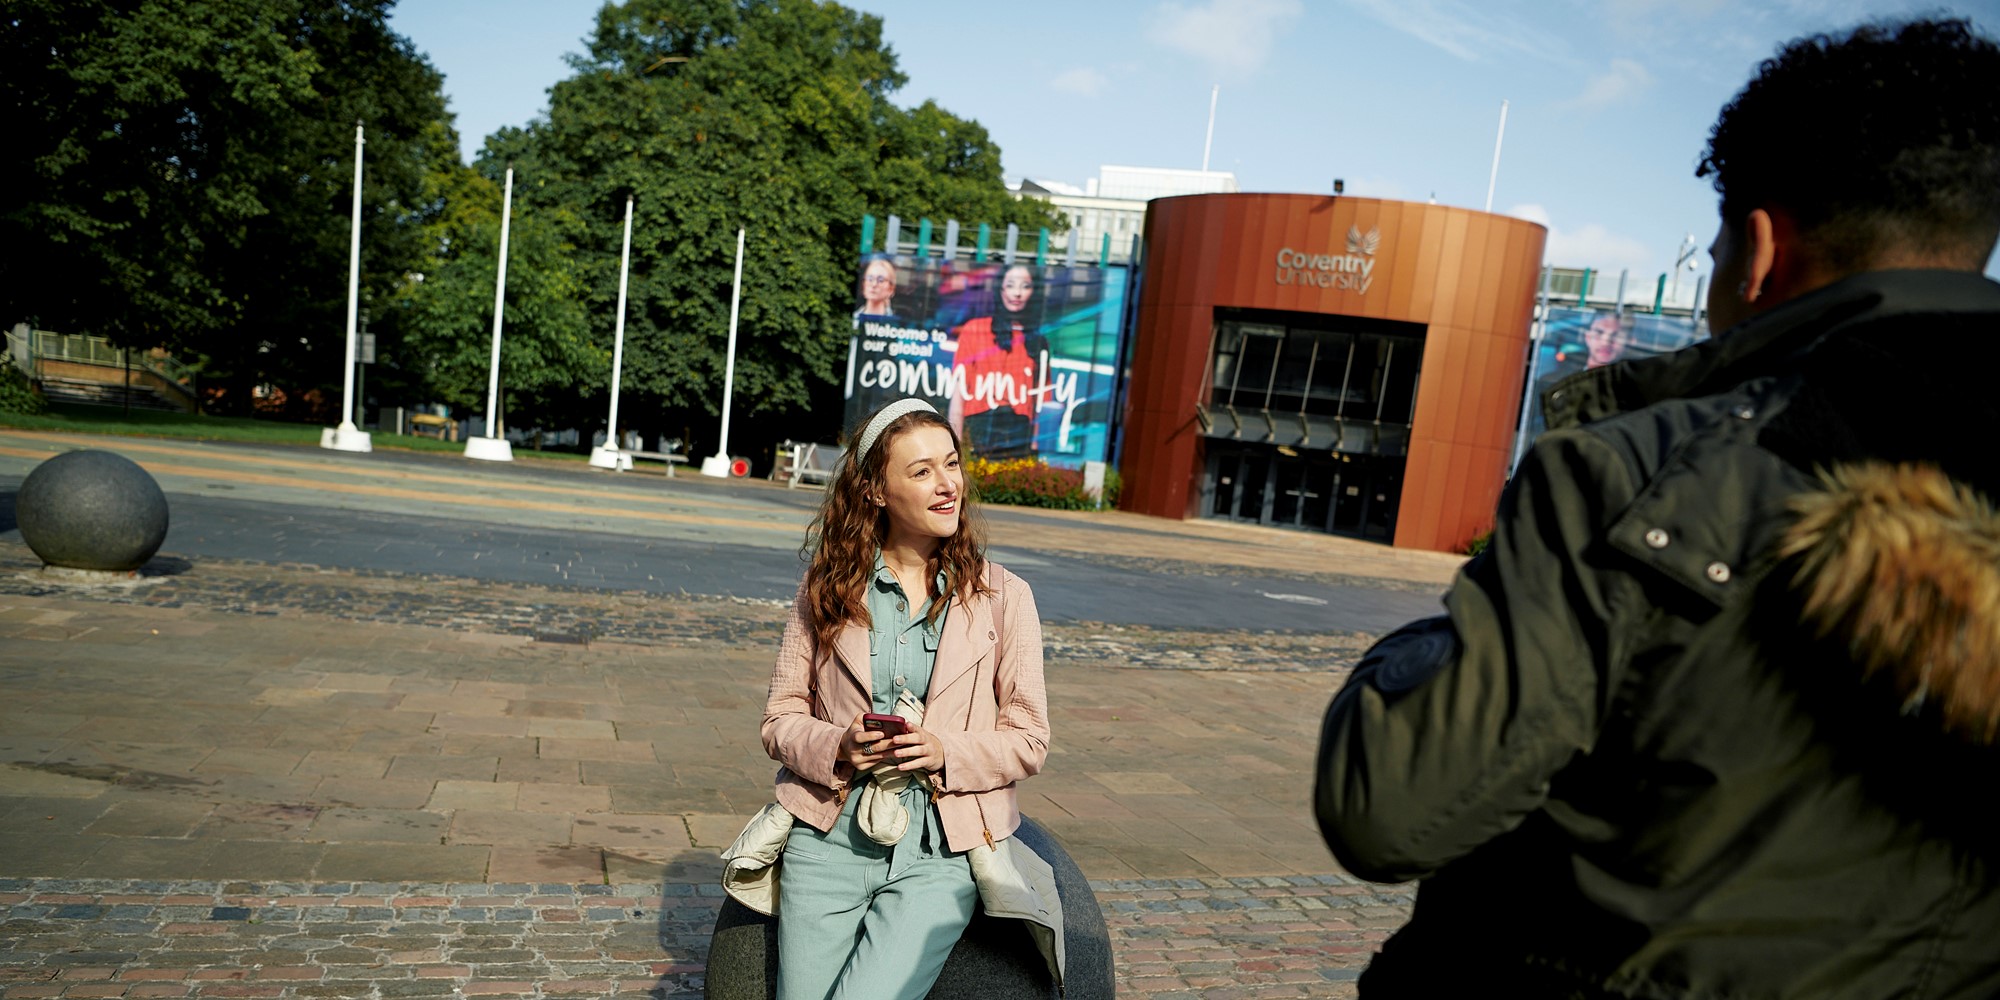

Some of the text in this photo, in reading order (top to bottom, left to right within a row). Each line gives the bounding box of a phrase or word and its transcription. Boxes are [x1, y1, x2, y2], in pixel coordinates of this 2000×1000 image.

[1277, 248, 1375, 277] Coventry
[1276, 267, 1373, 295] University
[864, 321, 947, 342] Welcome to
[863, 340, 933, 357] our global
[859, 350, 1087, 449] community
